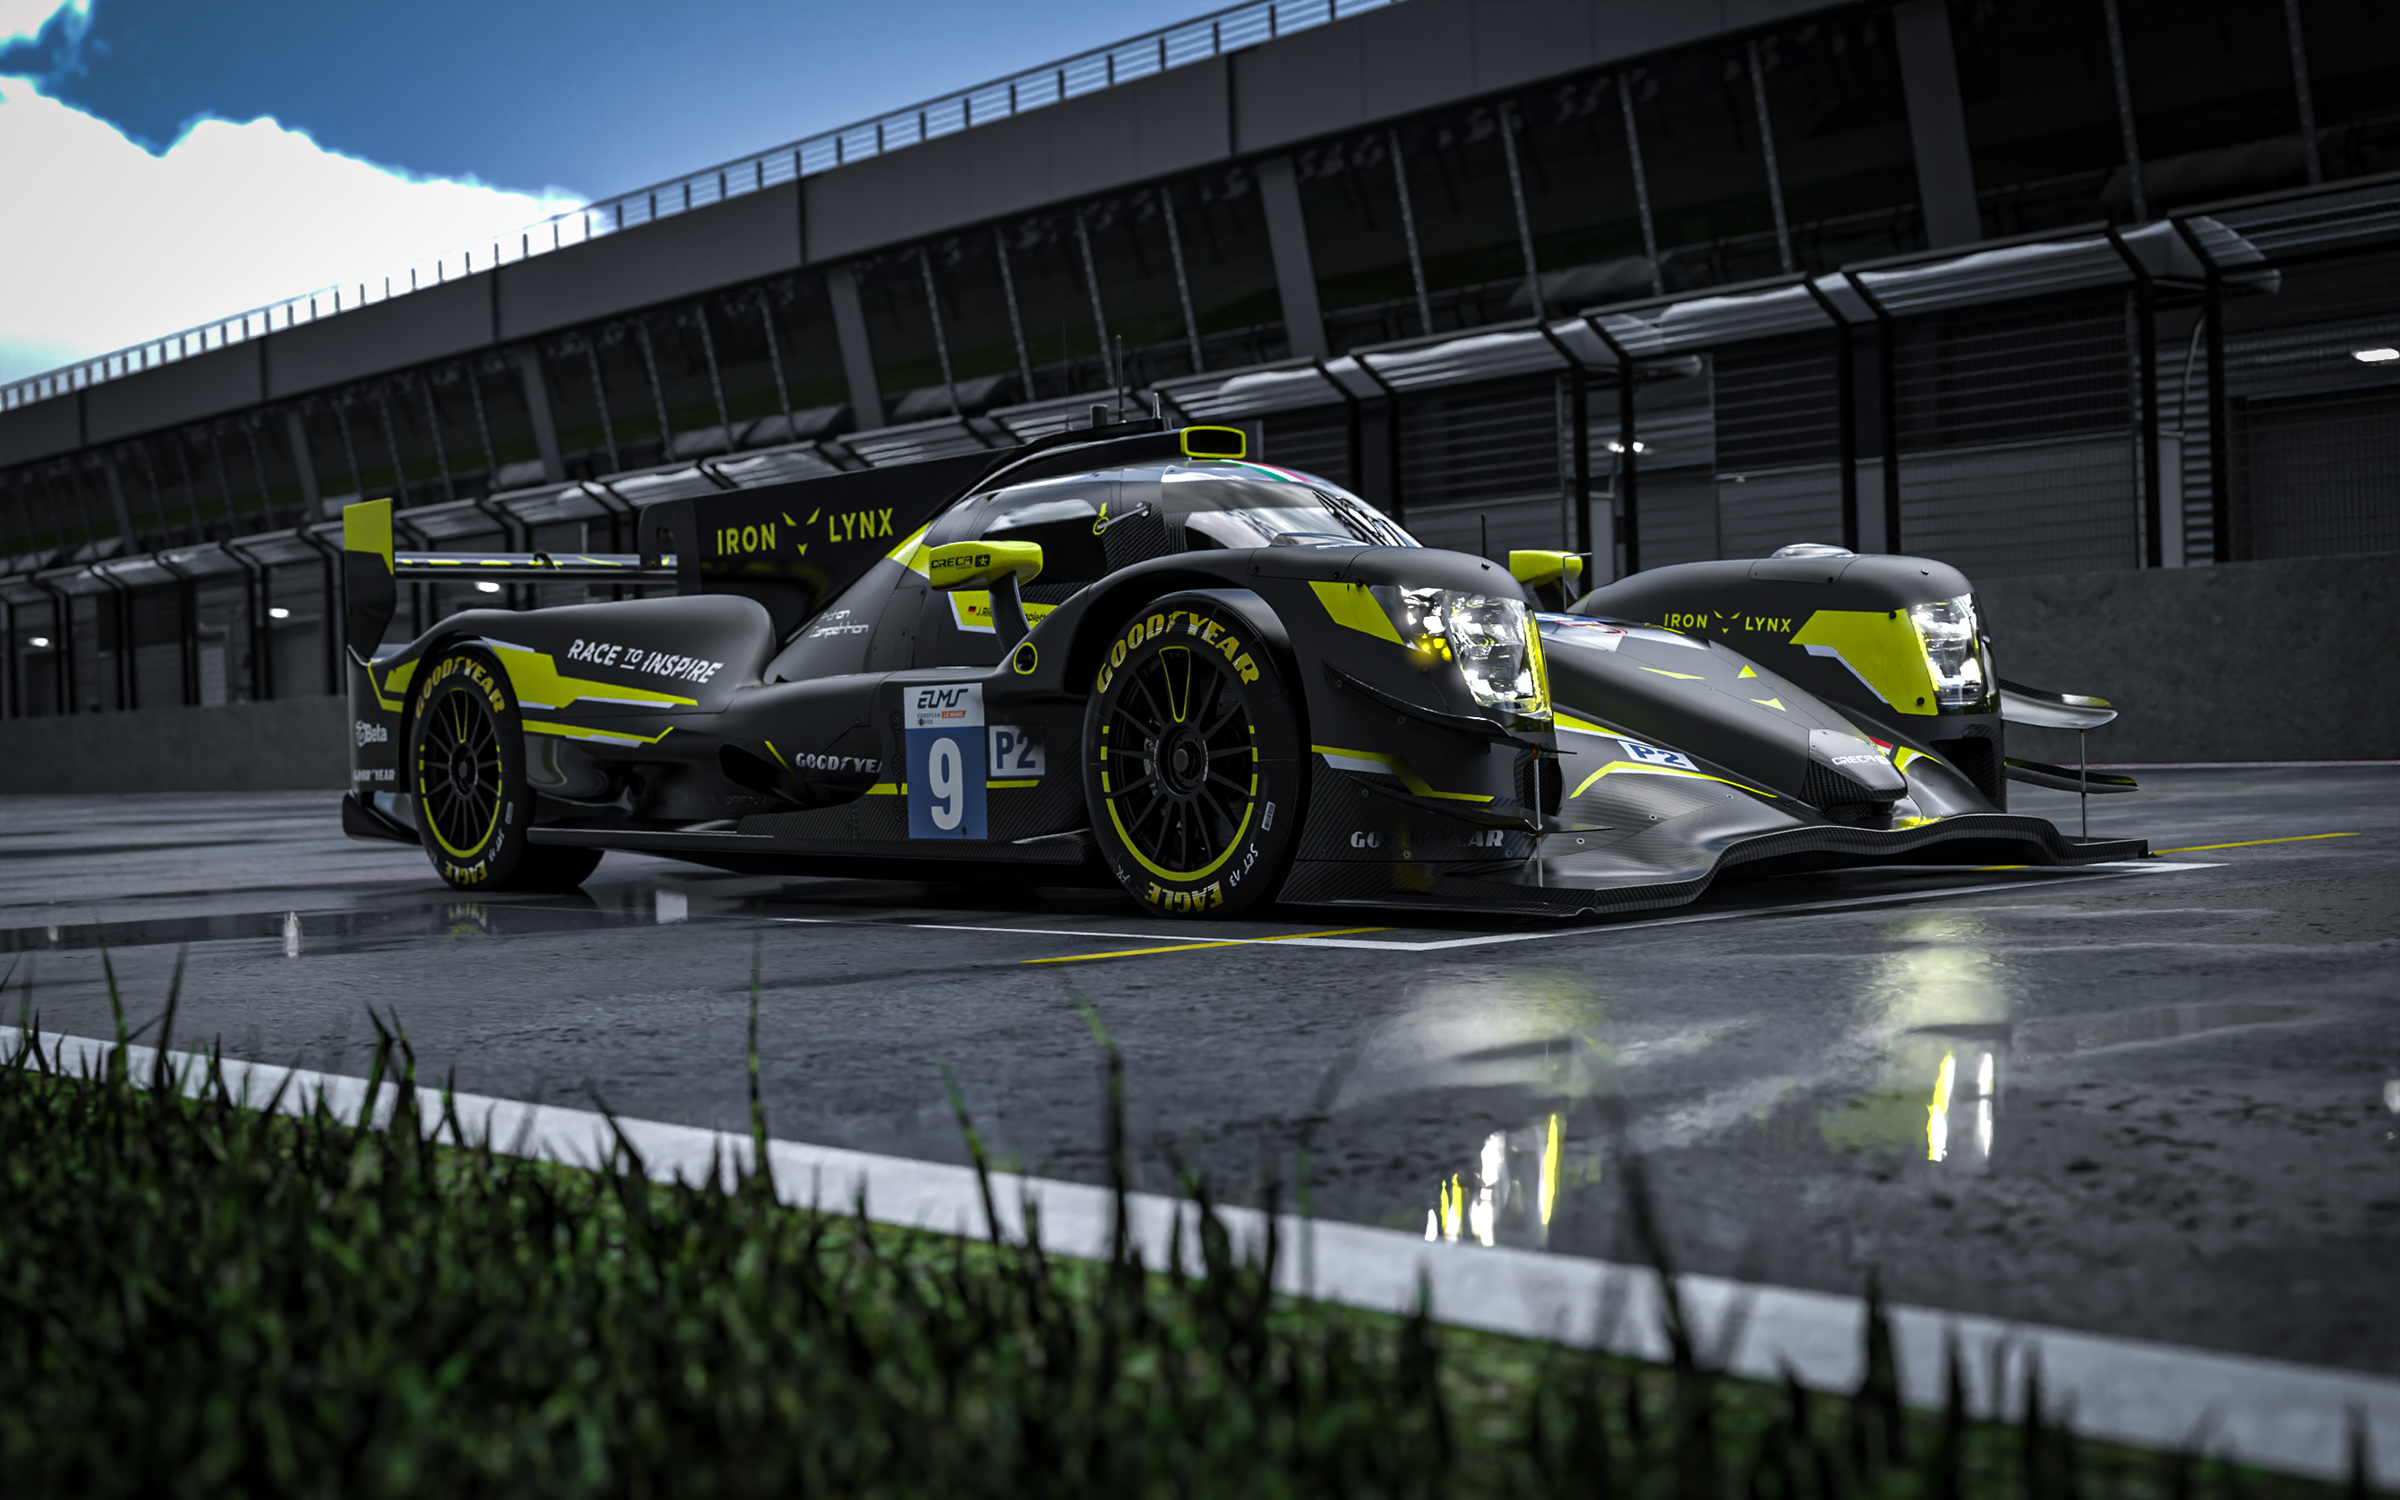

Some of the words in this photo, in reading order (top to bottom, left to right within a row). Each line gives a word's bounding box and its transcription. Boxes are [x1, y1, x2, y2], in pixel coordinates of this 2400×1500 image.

[717, 522, 776, 556] IRON
[829, 507, 894, 543] LYNX
[931, 555, 973, 569] ORECA
[1664, 613, 1708, 628] IRON
[1744, 616, 1792, 633] LYNX
[567, 638, 623, 666] RACE
[623, 647, 644, 663] TO
[640, 651, 725, 684] INSPIRE
[1097, 610, 1260, 694] GOODYEAR
[415, 656, 505, 719] GOODYEAR
[917, 688, 969, 709] ELMS
[364, 723, 388, 743] Beta
[795, 753, 883, 773] GOODYE
[995, 731, 1036, 770] P2
[1628, 742, 1688, 768] P2
[928, 737, 964, 831] 9
[1243, 842, 1259, 875] SET
[1144, 881, 1224, 913] EAGLE
